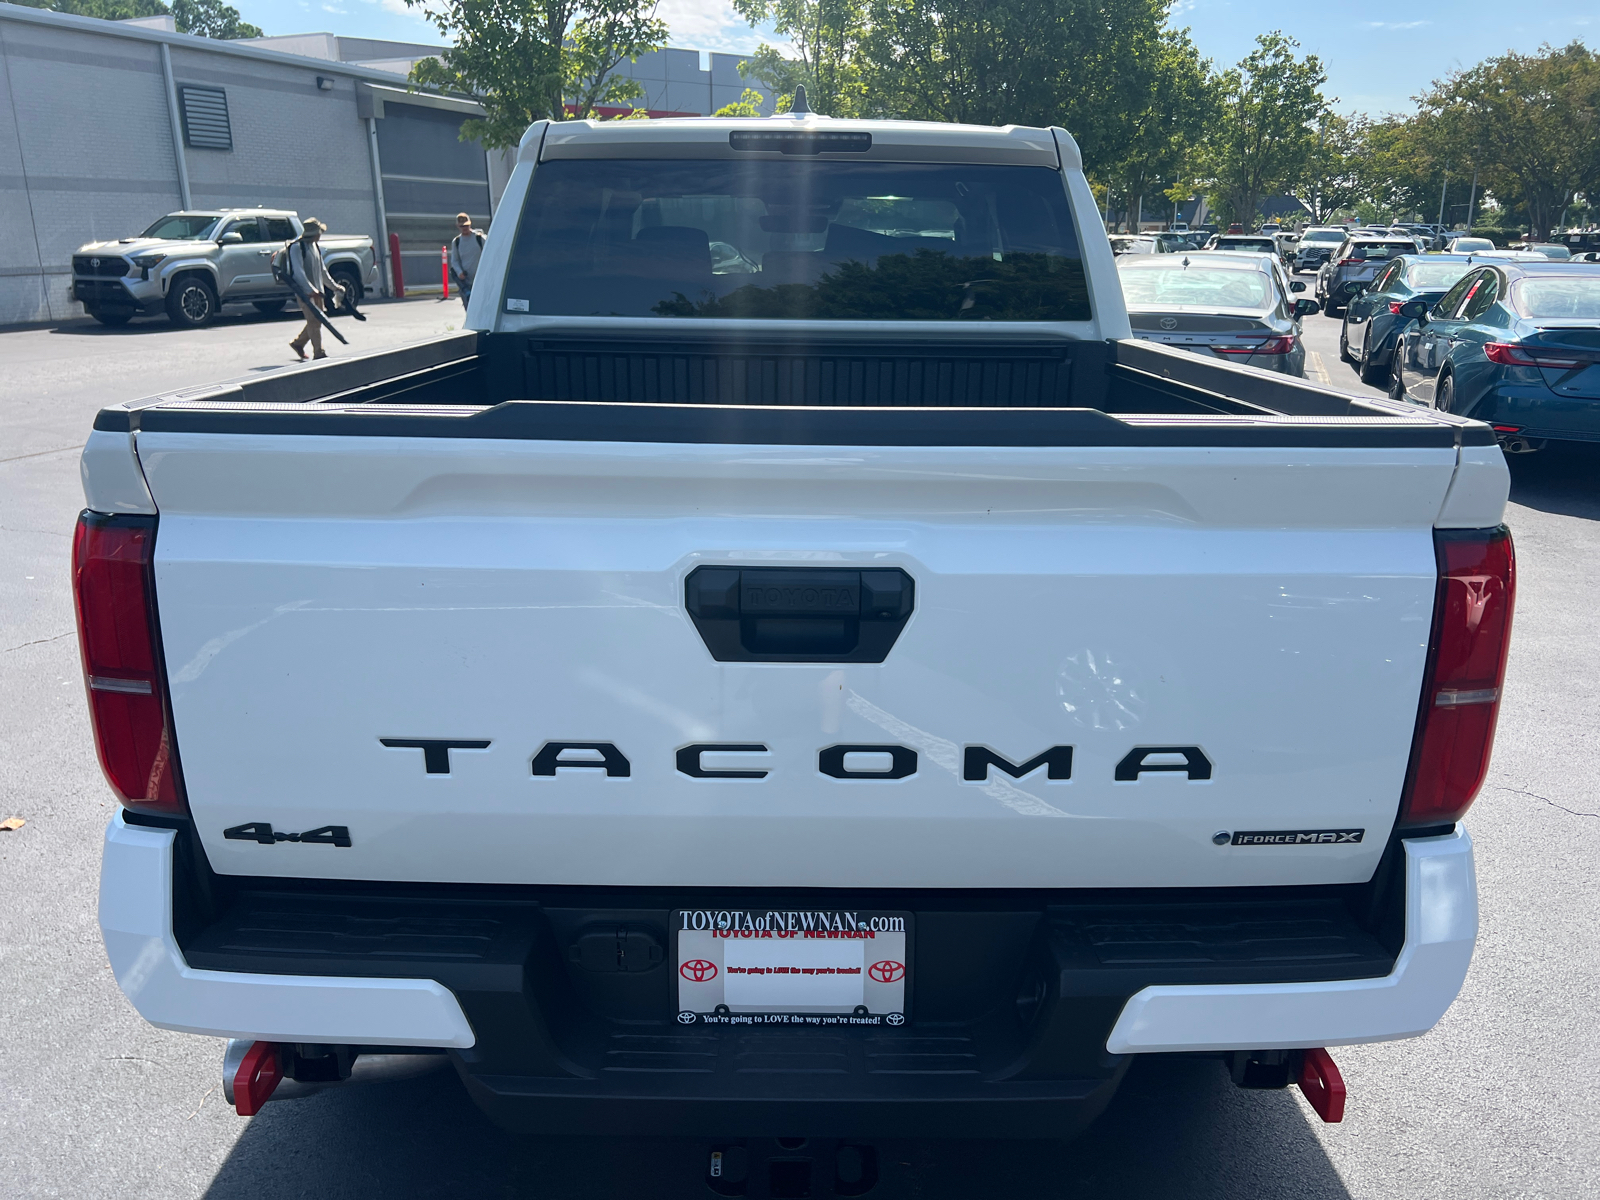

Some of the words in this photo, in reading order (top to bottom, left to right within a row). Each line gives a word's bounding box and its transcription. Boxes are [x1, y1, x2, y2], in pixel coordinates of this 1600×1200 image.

[747, 587, 855, 607] TOYOTA
[379, 738, 1213, 782] TACOMA
[702, 1014, 730, 1024] You're
[730, 1015, 753, 1025] going
[754, 1015, 763, 1023] to
[763, 1015, 790, 1023] LOVE
[790, 1015, 804, 1023] the
[805, 1016, 821, 1025] way
[822, 1015, 848, 1025] you're
[849, 1015, 881, 1025] treated!
